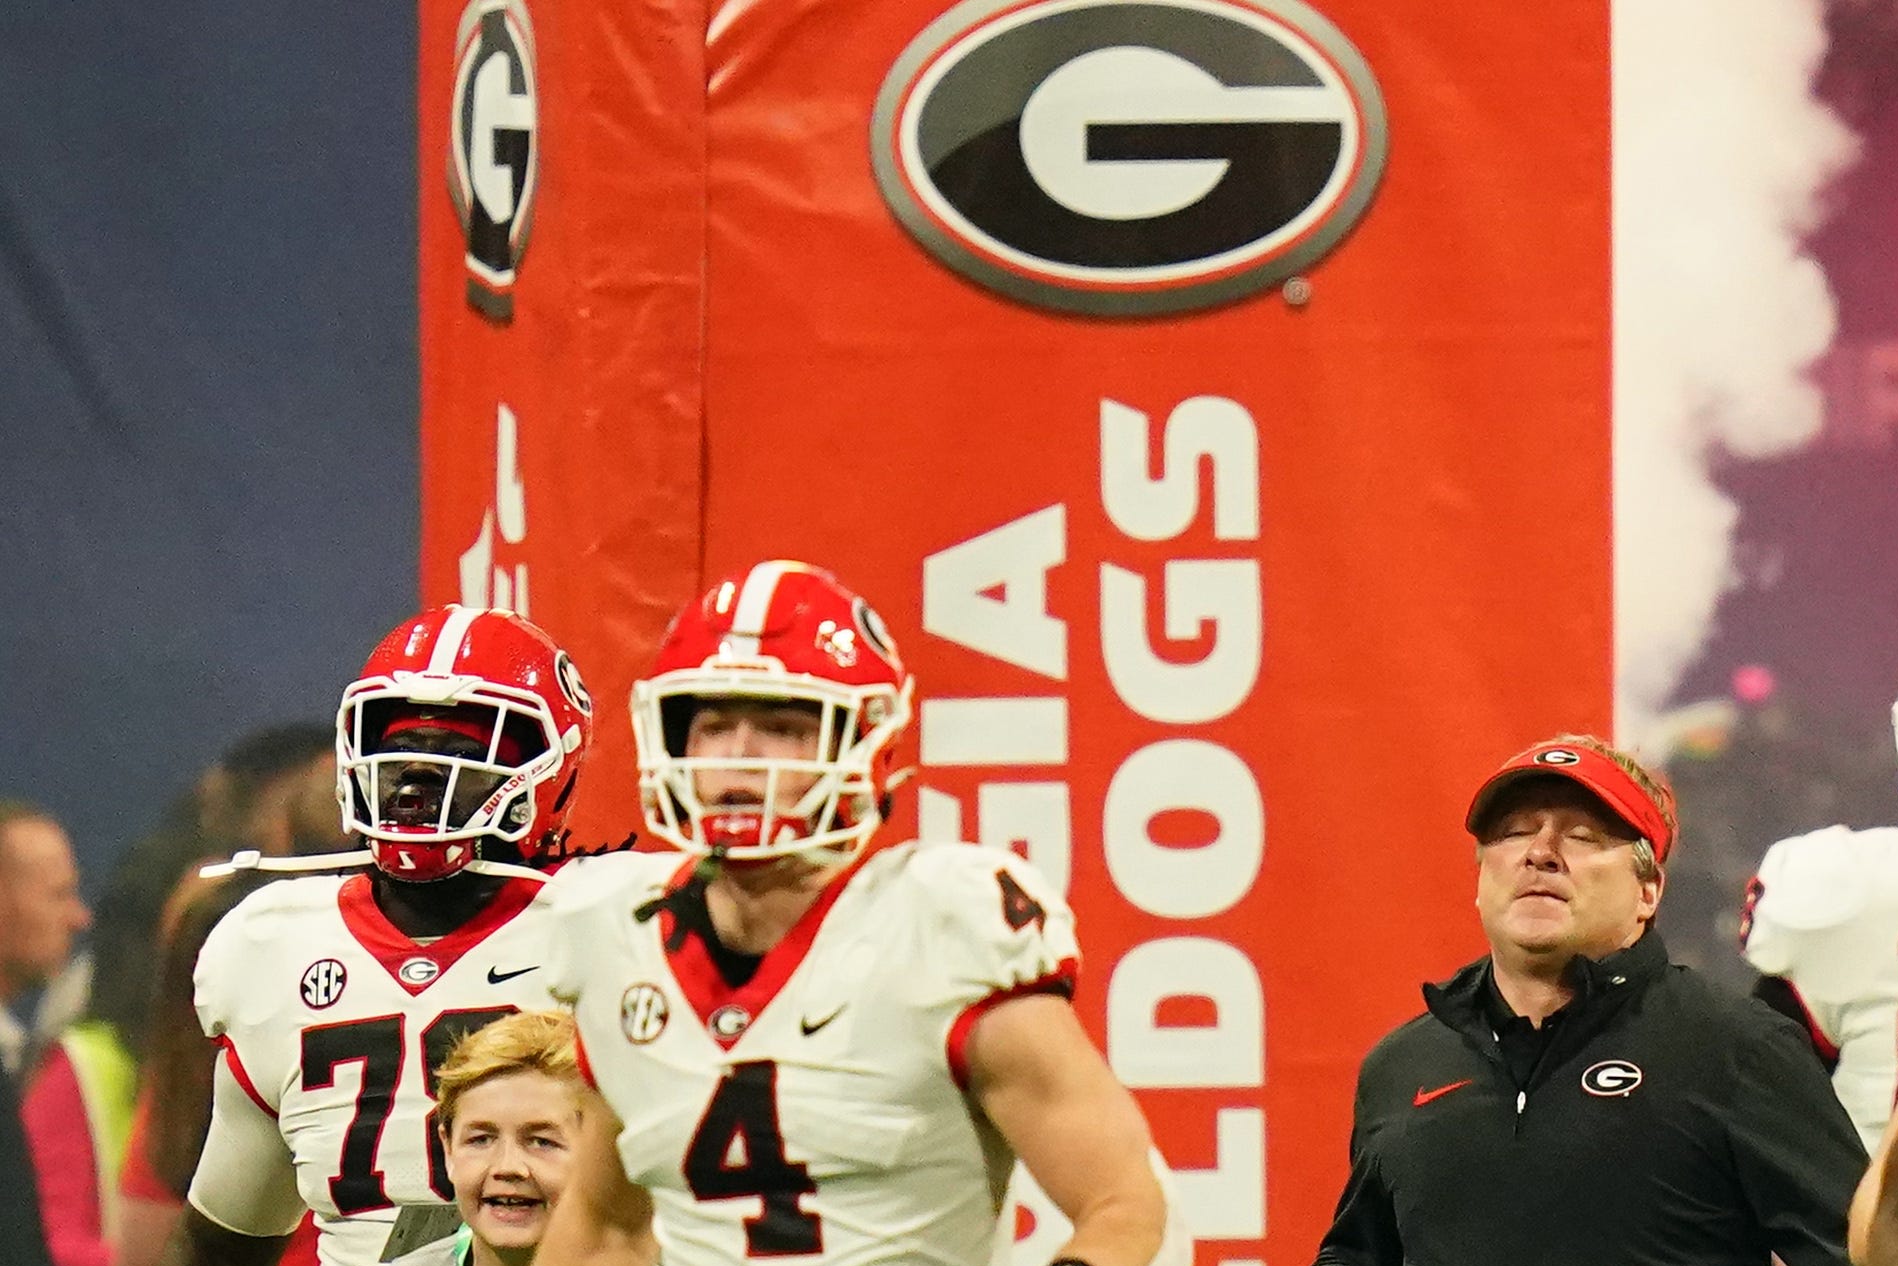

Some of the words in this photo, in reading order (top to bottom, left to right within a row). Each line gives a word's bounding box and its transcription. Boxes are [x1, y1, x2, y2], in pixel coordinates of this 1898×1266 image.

[1018, 46, 1355, 220] G
[303, 960, 345, 1007] SEC
[682, 1059, 825, 1258] 4
